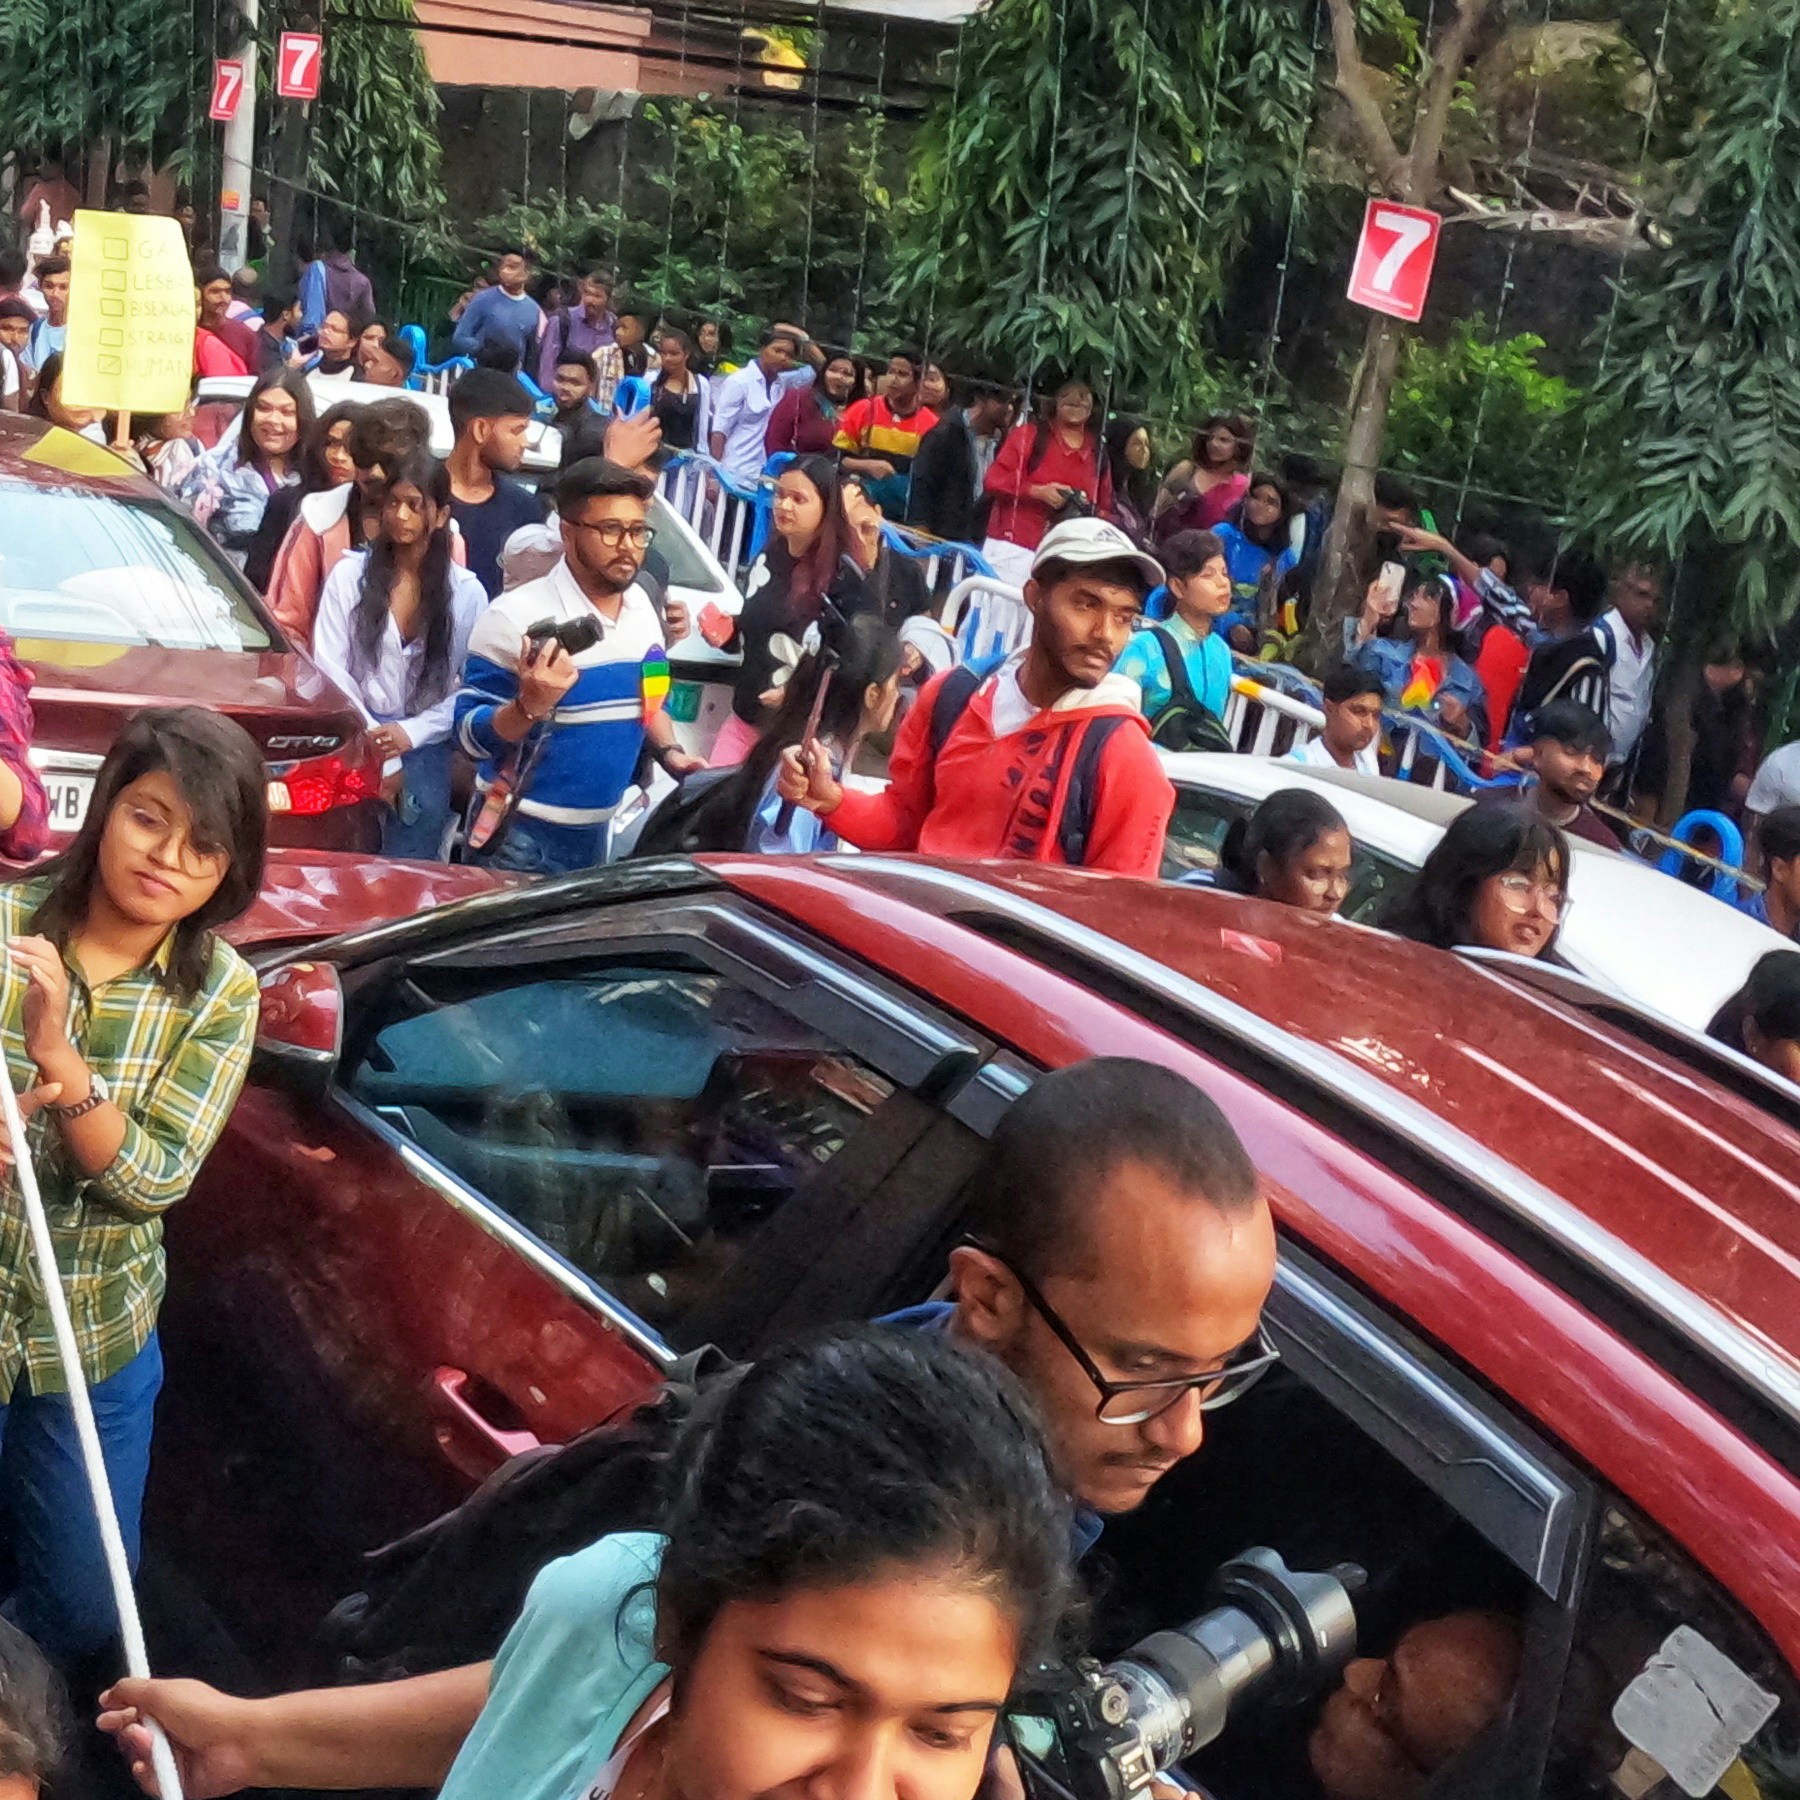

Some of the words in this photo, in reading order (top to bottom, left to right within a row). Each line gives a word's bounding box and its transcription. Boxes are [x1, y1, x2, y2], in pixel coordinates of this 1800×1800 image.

[287, 40, 318, 86] 7
[217, 67, 242, 108] 7
[1373, 212, 1432, 293] 7
